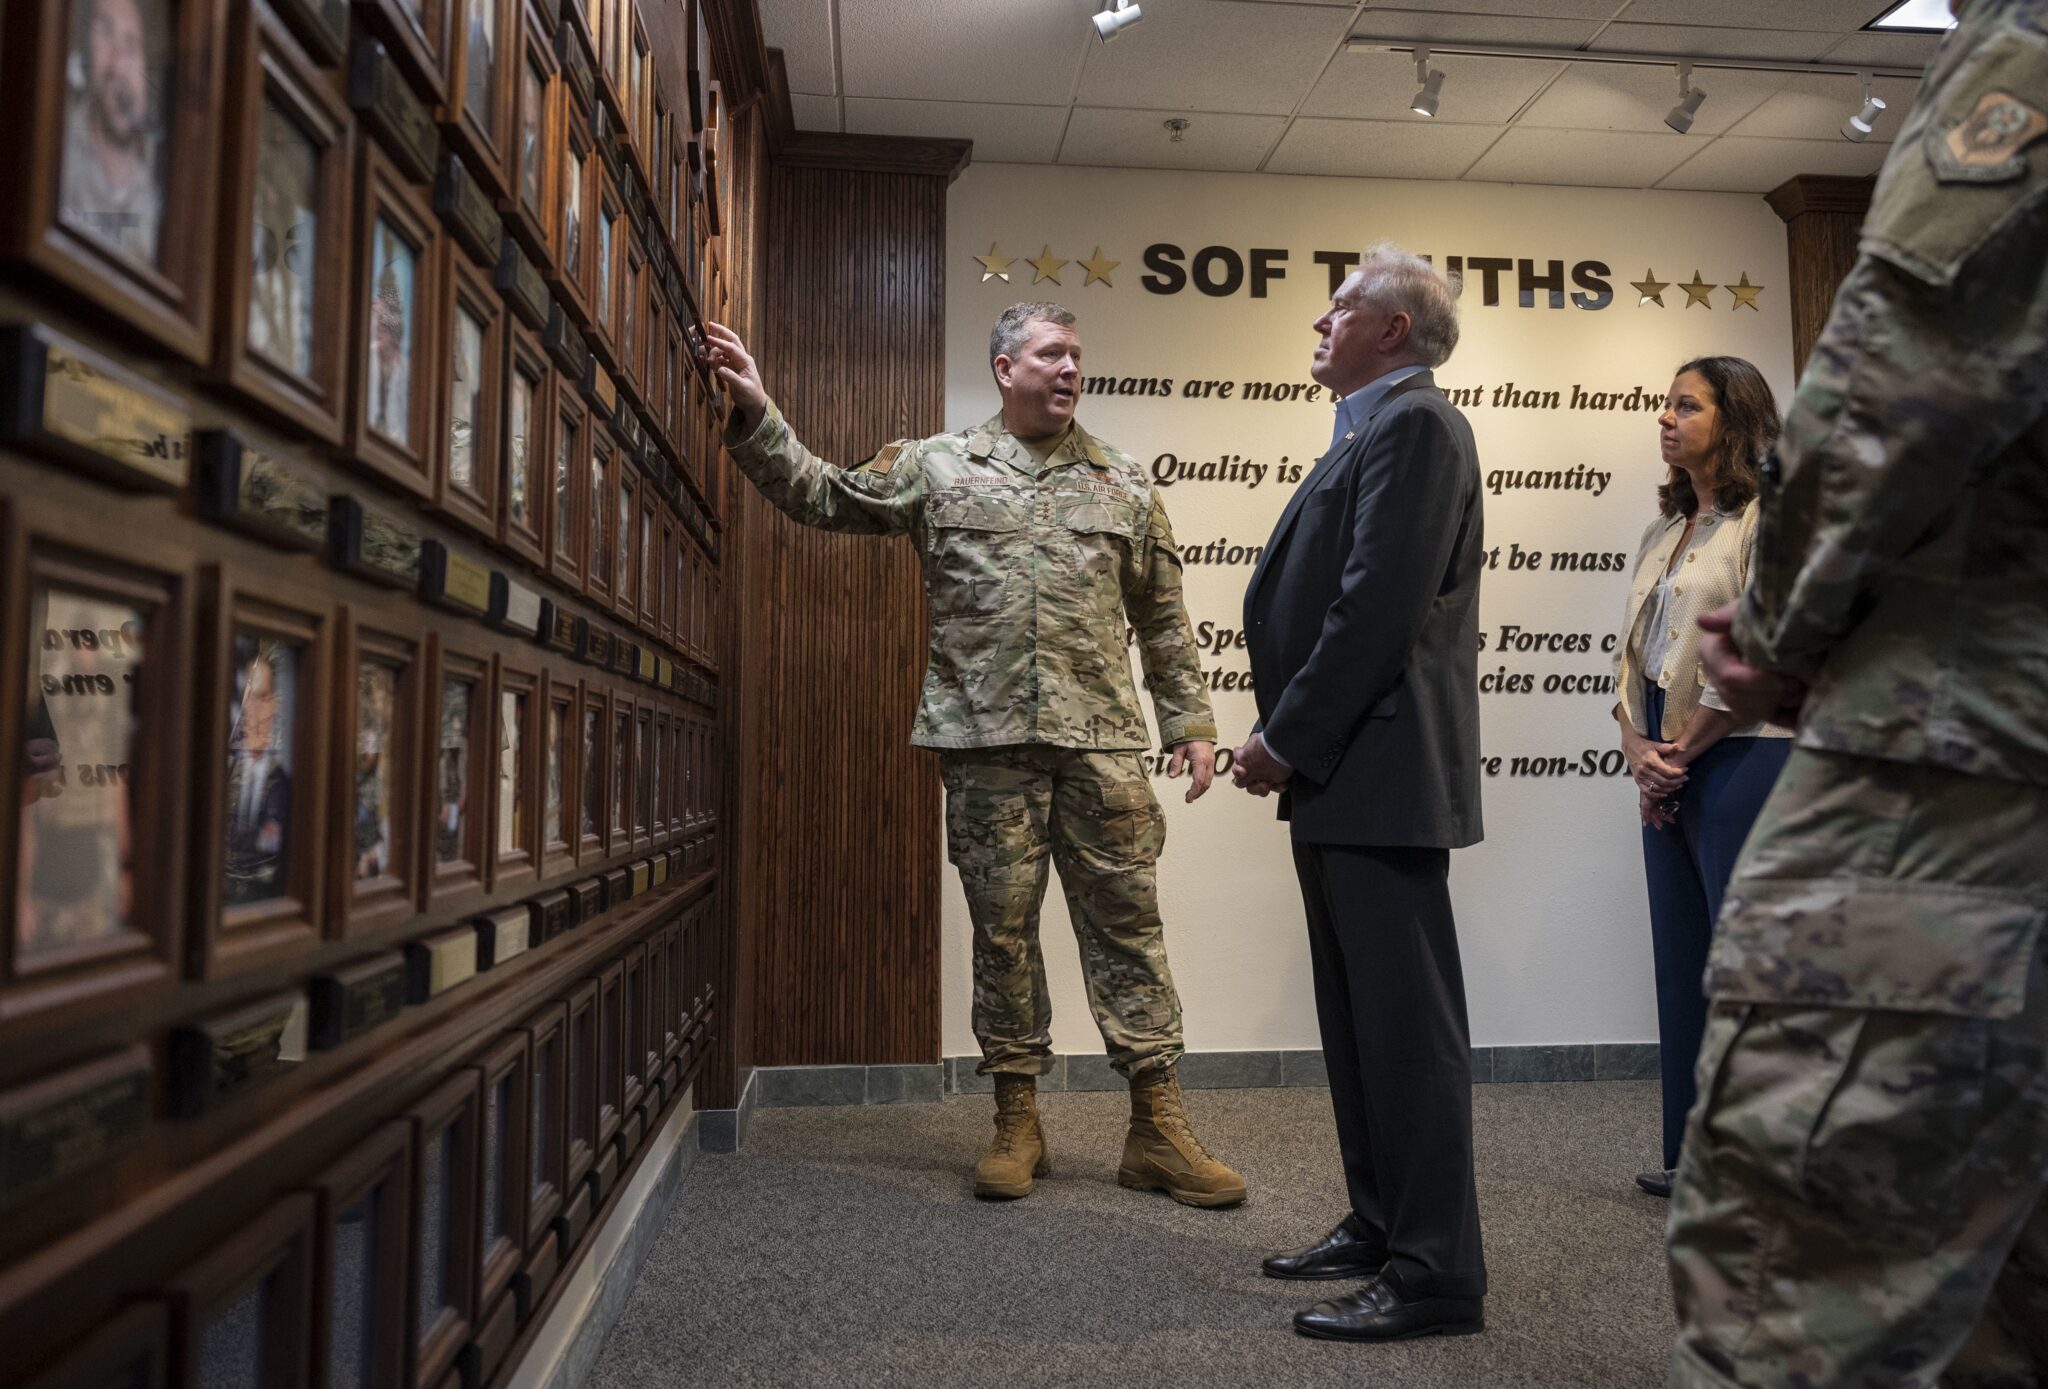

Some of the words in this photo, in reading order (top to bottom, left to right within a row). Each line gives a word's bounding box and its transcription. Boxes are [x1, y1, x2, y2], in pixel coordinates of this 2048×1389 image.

[1141, 243, 1289, 298] SOF
[1080, 375, 1173, 397] mans
[1183, 379, 1235, 399] are
[1242, 381, 1322, 402] more
[1492, 382, 1560, 409] than
[1569, 384, 1670, 412] hardw
[954, 475, 1009, 487] BAUERNFEIND
[1152, 453, 1268, 489] Quality
[1277, 456, 1302, 484] is
[1486, 463, 1612, 497] quantity
[1093, 484, 1106, 494] AIR
[1106, 486, 1129, 500] FORCE
[1507, 543, 1542, 571] be
[1550, 551, 1626, 572] mass
[1495, 625, 1592, 652] Forces
[1510, 748, 1633, 777] non-SO
